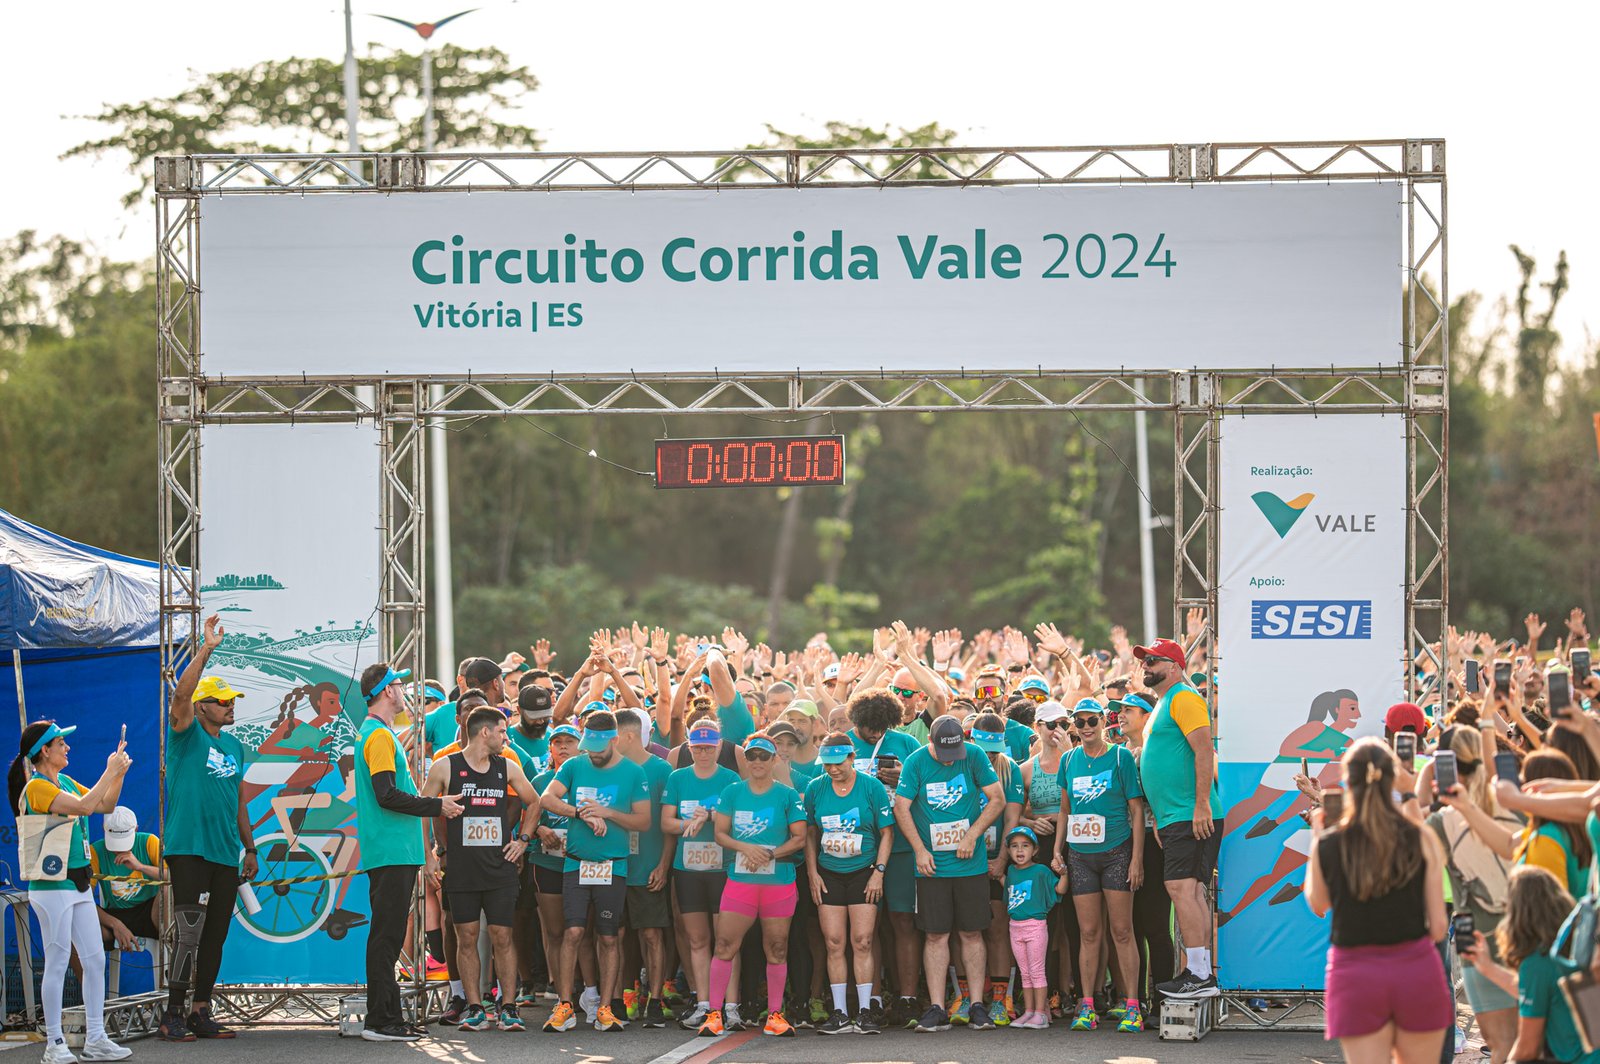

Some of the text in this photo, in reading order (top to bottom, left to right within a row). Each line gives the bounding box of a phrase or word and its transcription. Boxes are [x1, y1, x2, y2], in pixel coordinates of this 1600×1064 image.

[412, 229, 1177, 284] Circuito Corrida Vale 2024
[413, 301, 521, 328] Vitória
[548, 303, 583, 327] ES
[687, 440, 839, 483] 0:00:00
[1250, 464, 1313, 479] Realização:
[1315, 514, 1376, 532] VALE
[1249, 576, 1285, 589] Apoio:
[1262, 605, 1360, 636] SESI
[461, 788, 504, 798] ATLETISMO
[467, 825, 498, 840] 2016
[1072, 823, 1102, 837] 649
[826, 839, 856, 853] 2511
[687, 850, 719, 864] 2502
[581, 865, 612, 878] 2522
